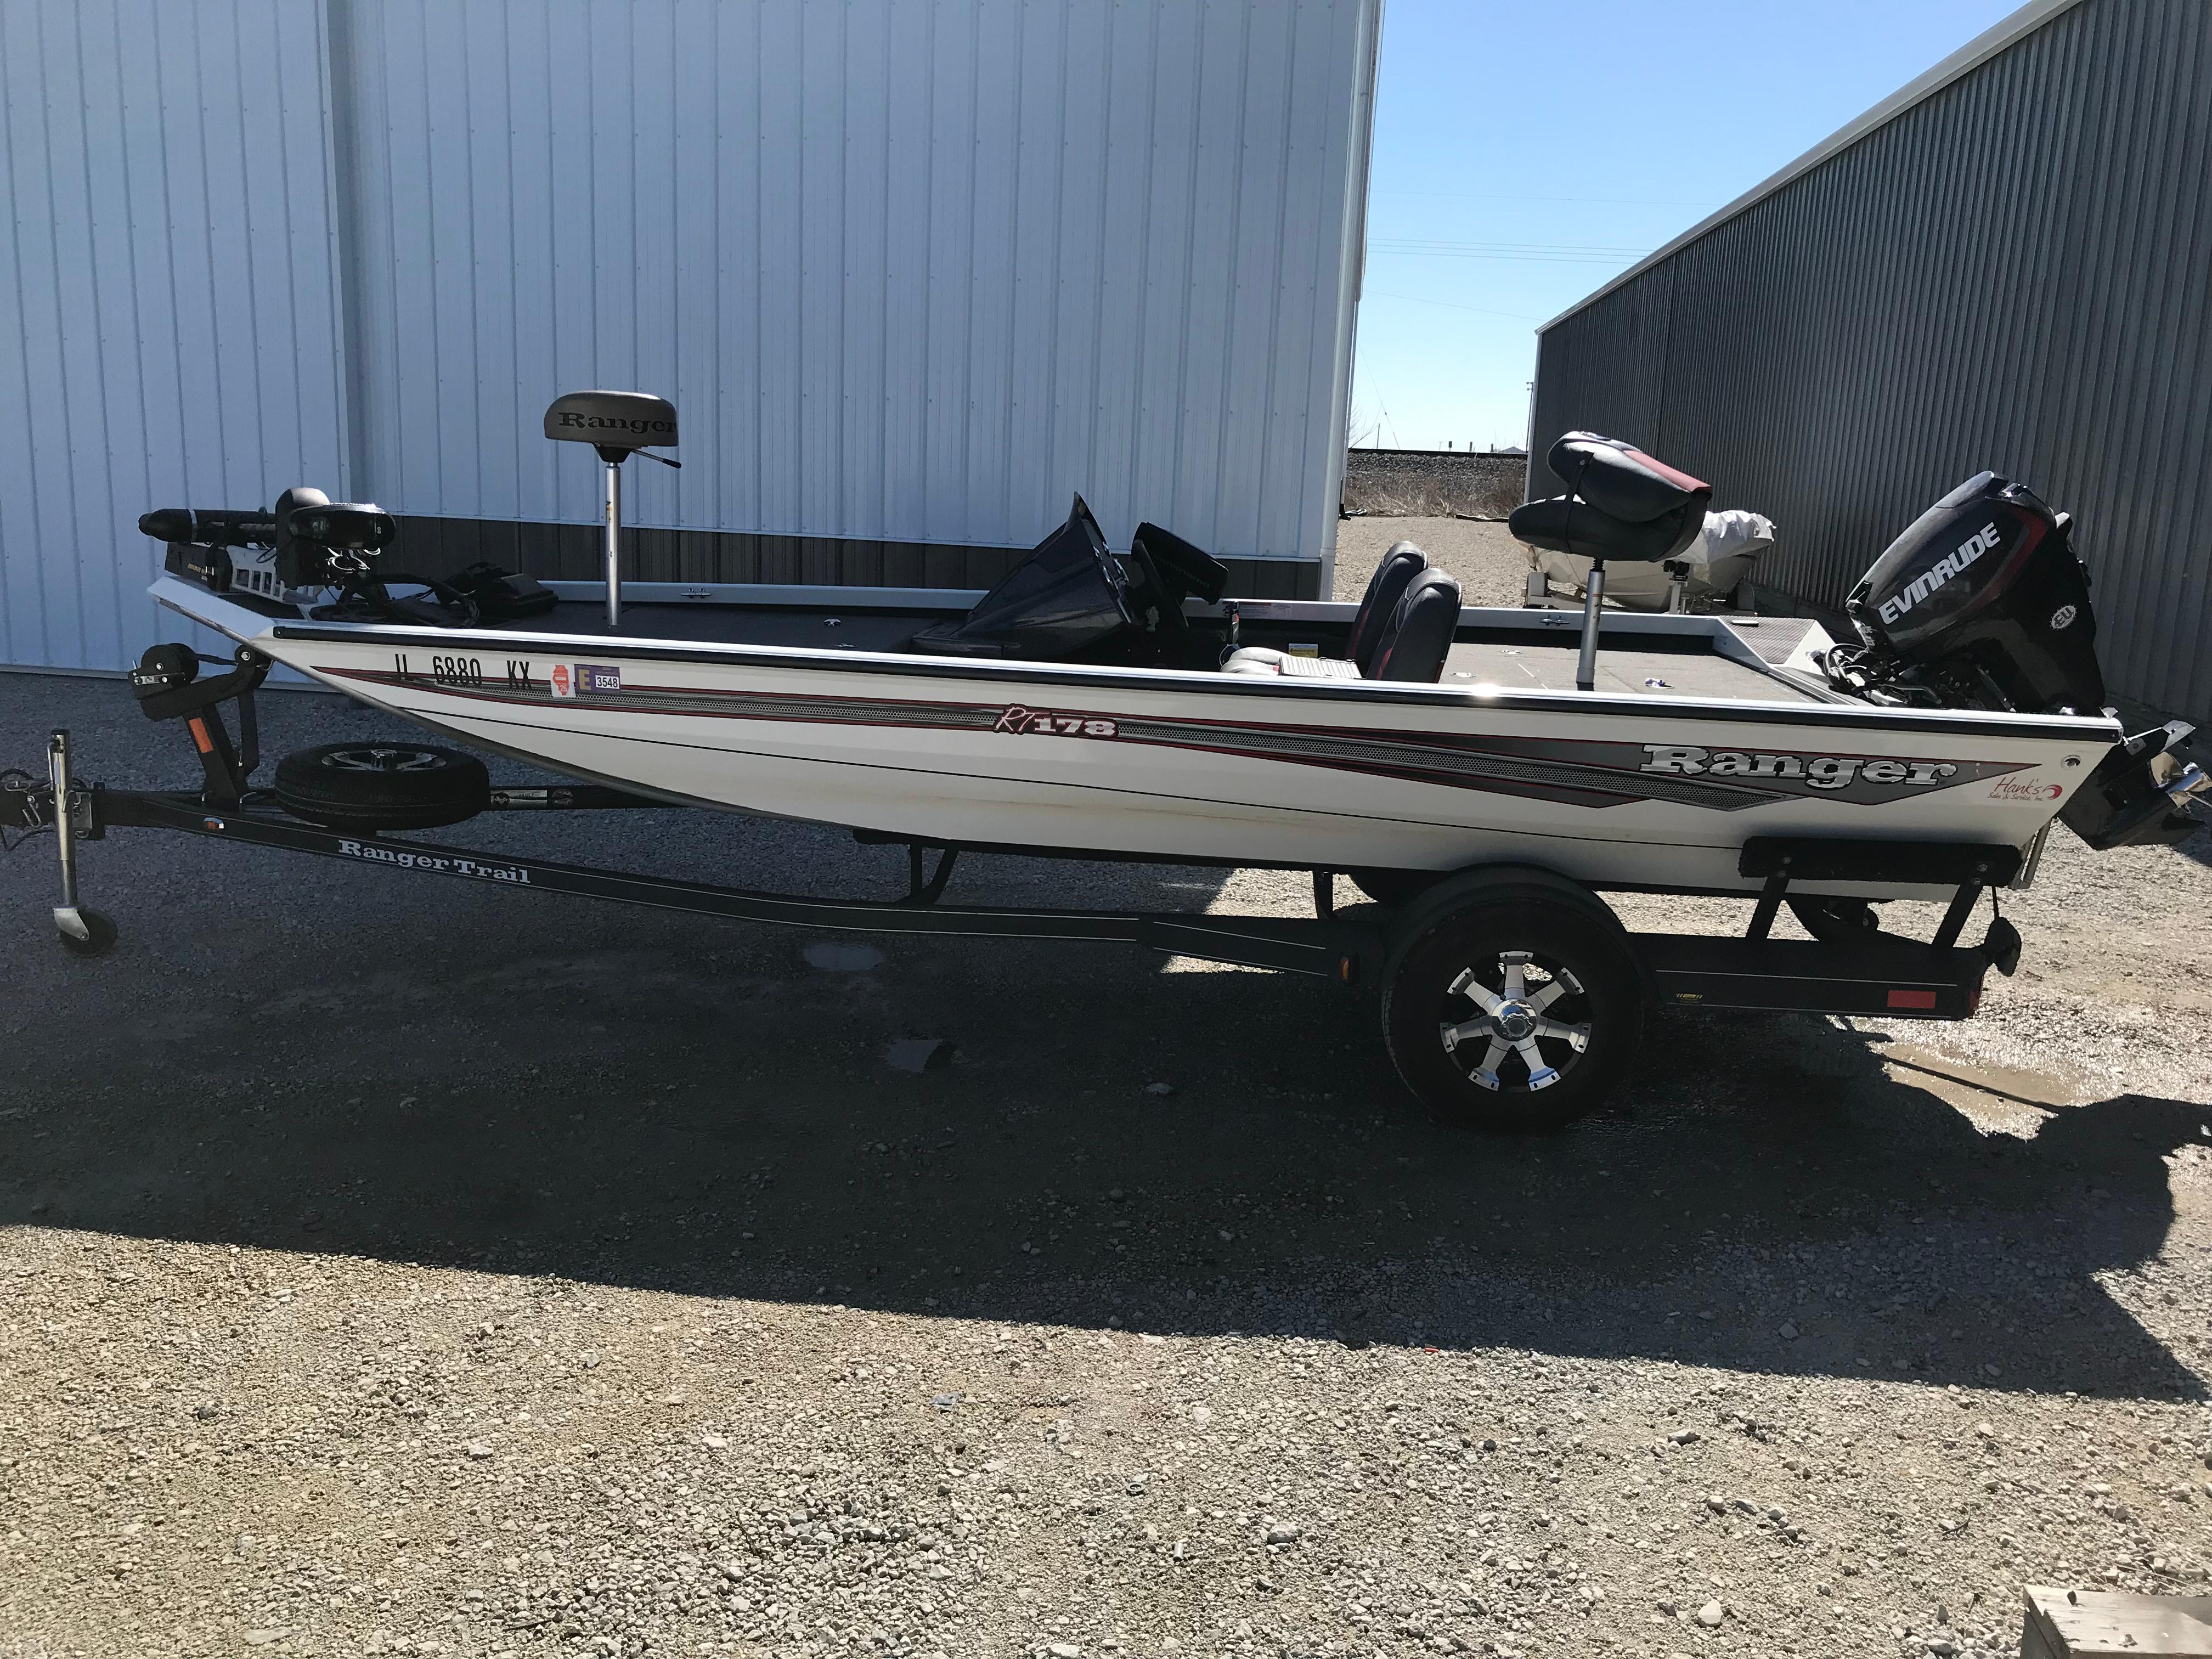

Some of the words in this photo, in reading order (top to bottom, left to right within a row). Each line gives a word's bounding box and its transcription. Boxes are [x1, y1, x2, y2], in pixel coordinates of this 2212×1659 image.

[558, 412, 676, 433] Ranger
[1878, 522, 2001, 624] EVINRUDE
[433, 656, 482, 686] 6880
[507, 660, 532, 690] KX
[578, 669, 591, 690] E
[597, 677, 618, 688] 3548
[1639, 744, 1957, 789] Ranger
[1994, 777, 2042, 794] Hank's
[338, 839, 449, 868] Ranger
[453, 859, 531, 883] Trail
